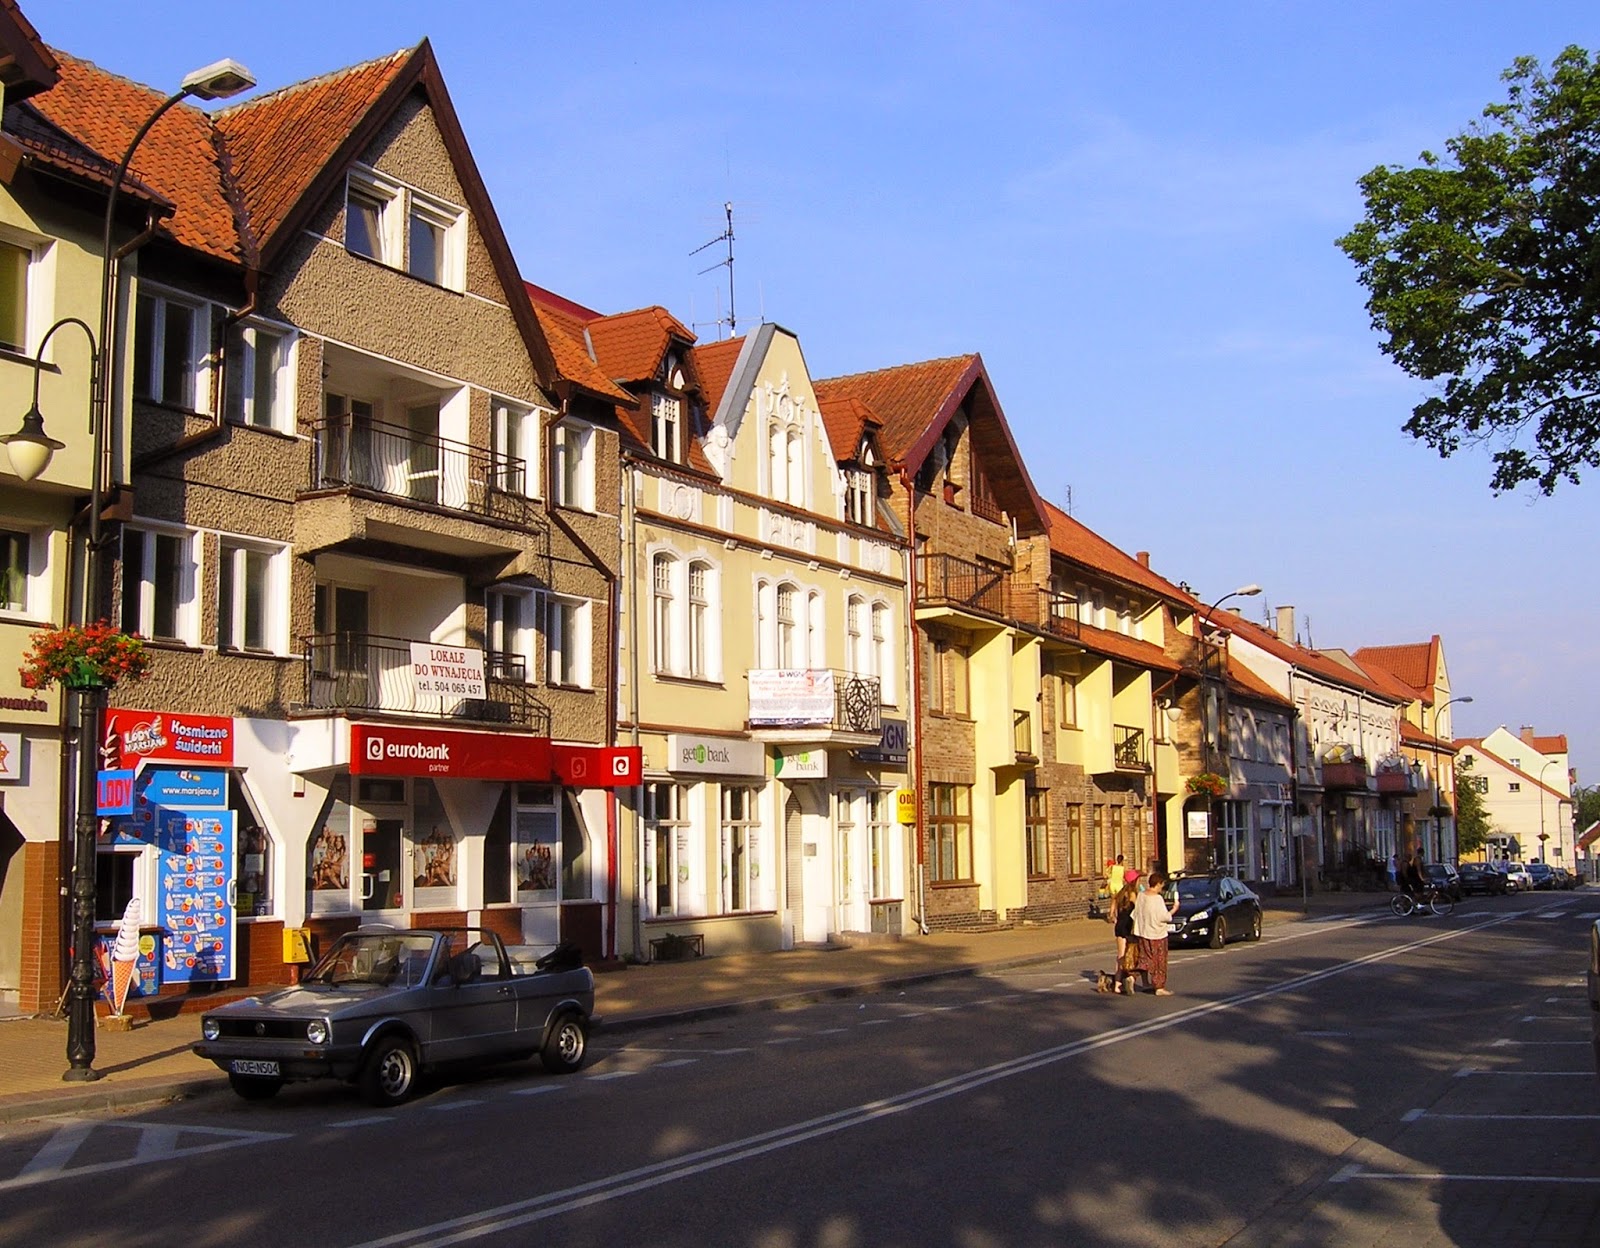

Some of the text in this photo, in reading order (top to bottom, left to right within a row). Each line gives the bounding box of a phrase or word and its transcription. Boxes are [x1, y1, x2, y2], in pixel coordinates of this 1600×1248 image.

[430, 649, 466, 664] LOKALE
[414, 663, 482, 682] DO WYNAJĘCIA
[418, 680, 482, 695] tel. 504 065 457
[123, 727, 152, 744] LODY
[170, 719, 229, 739] Kosmiczne
[124, 736, 168, 753] MARSJANO
[174, 736, 222, 754] świderki
[386, 741, 450, 760] eurobank
[682, 744, 730, 763] getin bank
[428, 763, 450, 773] partner
[795, 761, 819, 772] bank
[97, 778, 133, 809] LODY
[162, 786, 220, 798] www.marsjano.pl
[236, 1061, 279, 1075] NOE N504
